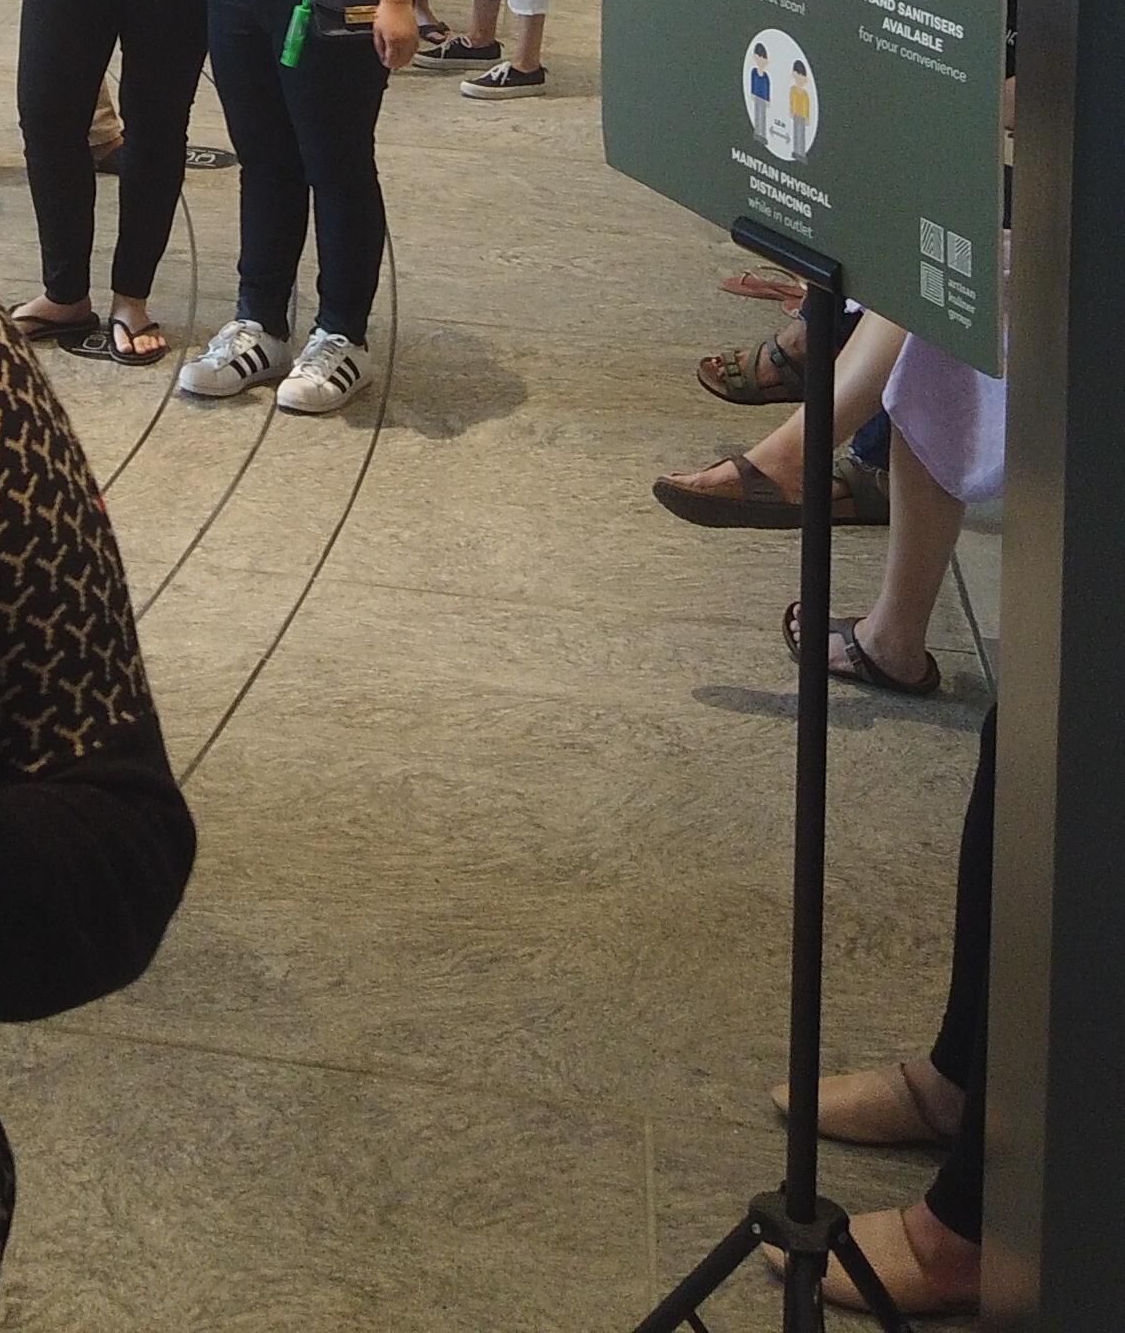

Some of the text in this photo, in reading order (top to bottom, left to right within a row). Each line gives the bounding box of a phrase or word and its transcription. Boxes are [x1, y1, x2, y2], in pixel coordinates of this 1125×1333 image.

[882, 17, 943, 53] AVAILABLE
[897, 1, 964, 39] SANITISERS
[858, 25, 967, 83] for your convenience
[731, 147, 832, 209] MAINTAIN PHYSICAL
[750, 175, 812, 219] DISTANCING
[747, 197, 813, 239] while in outlet
